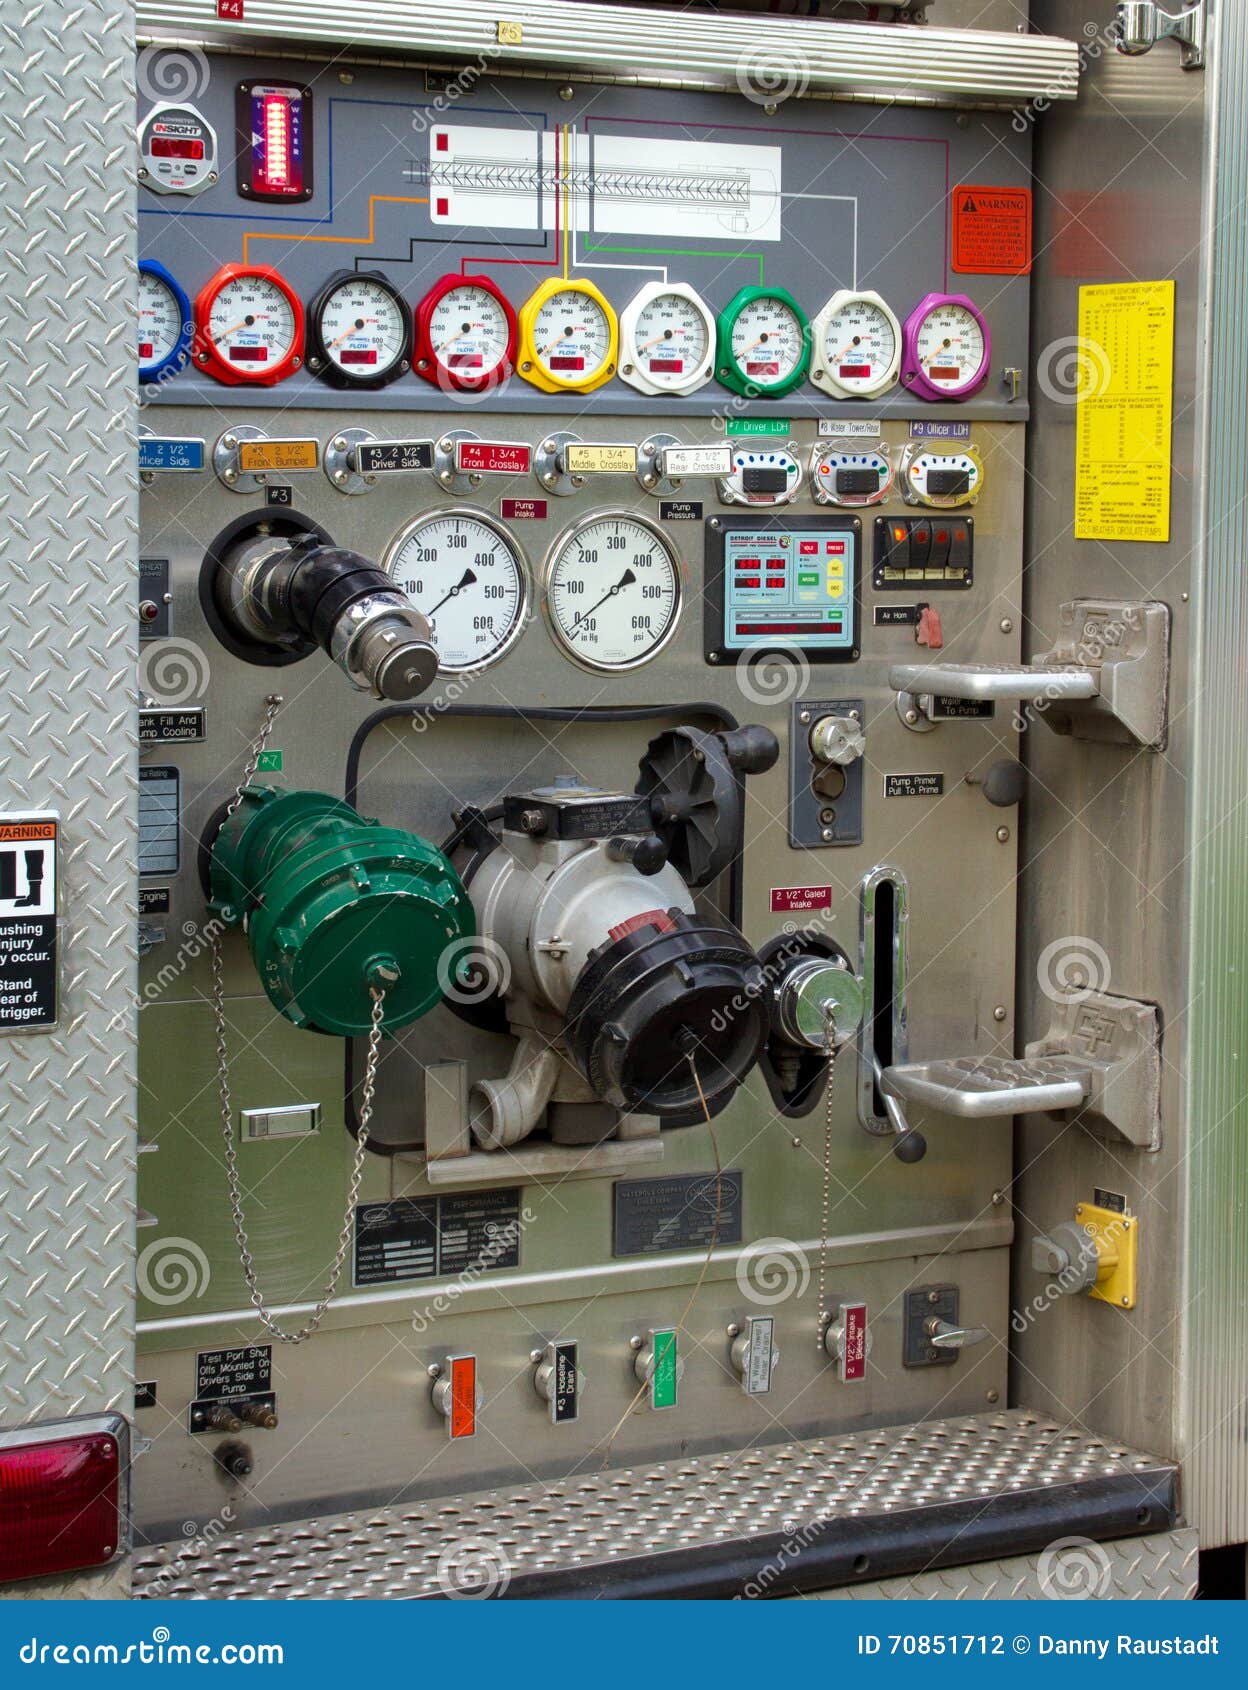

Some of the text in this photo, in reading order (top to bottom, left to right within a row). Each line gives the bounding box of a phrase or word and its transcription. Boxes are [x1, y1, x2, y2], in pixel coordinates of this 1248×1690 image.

[221, 1, 240, 15] #4
[155, 125, 199, 135] INSIGHT
[978, 199, 1024, 209] WARNING
[743, 421, 768, 431] Driver
[772, 422, 788, 432] LDH
[912, 423, 924, 434] #9
[953, 424, 968, 436] LDH
[157, 445, 188, 454] 2 1/2"
[275, 447, 281, 455] 2
[370, 447, 420, 457] #3 2 1/2"
[469, 448, 481, 456] #4
[499, 449, 519, 459] 3/4"
[578, 450, 589, 458] #5
[607, 449, 626, 458] 3/4"
[169, 456, 190, 466] Side
[248, 457, 309, 467] Front Bumper
[675, 452, 721, 461] #6 2 1/2"
[371, 458, 420, 469] Driver Side
[463, 457, 524, 472] Front Crosslay
[571, 460, 633, 471] Middle Crosslay
[670, 463, 726, 473] Rear Crosslay
[271, 489, 288, 503] #3
[515, 502, 535, 510] Pump
[672, 503, 691, 511] Pump
[515, 510, 535, 518] Intake
[667, 511, 696, 520] Pressure
[447, 535, 467, 549] 300
[607, 536, 626, 550] 300
[417, 549, 437, 562] 200
[474, 552, 495, 566] 400
[578, 550, 598, 563] 200
[633, 554, 652, 567] 400
[404, 580, 423, 594] 100
[484, 585, 504, 599] 500
[567, 581, 584, 594] 100
[642, 586, 662, 599] 500
[473, 616, 493, 630] 600
[631, 616, 651, 629] 600
[475, 632, 486, 643] psi
[581, 632, 599, 644] in Hg
[633, 632, 644, 642] psi
[945, 706, 956, 715] To
[160, 717, 173, 725] Fill
[179, 716, 197, 725] And
[163, 727, 197, 738] Cooling
[890, 777, 937, 786] Pump Primer
[888, 785, 939, 795] Pull To Prime
[139, 891, 167, 902] Engine
[776, 890, 826, 900] 2 1/2" Gated
[790, 901, 812, 909] Intake
[0, 923, 43, 936] ushing
[11, 951, 50, 963] occur.
[24, 991, 38, 1003] of
[0, 1006, 46, 1020] trigger.
[855, 1328, 864, 1360] Bleeder
[203, 1348, 268, 1363] Test Port Shut
[220, 1362, 254, 1374] Mounted
[258, 1359, 270, 1368] On
[199, 1376, 230, 1386] Drivers
[235, 1372, 254, 1382] Side
[566, 1370, 575, 1394] Drain
[222, 1384, 247, 1394] Pump
[557, 1398, 566, 1411] #3
